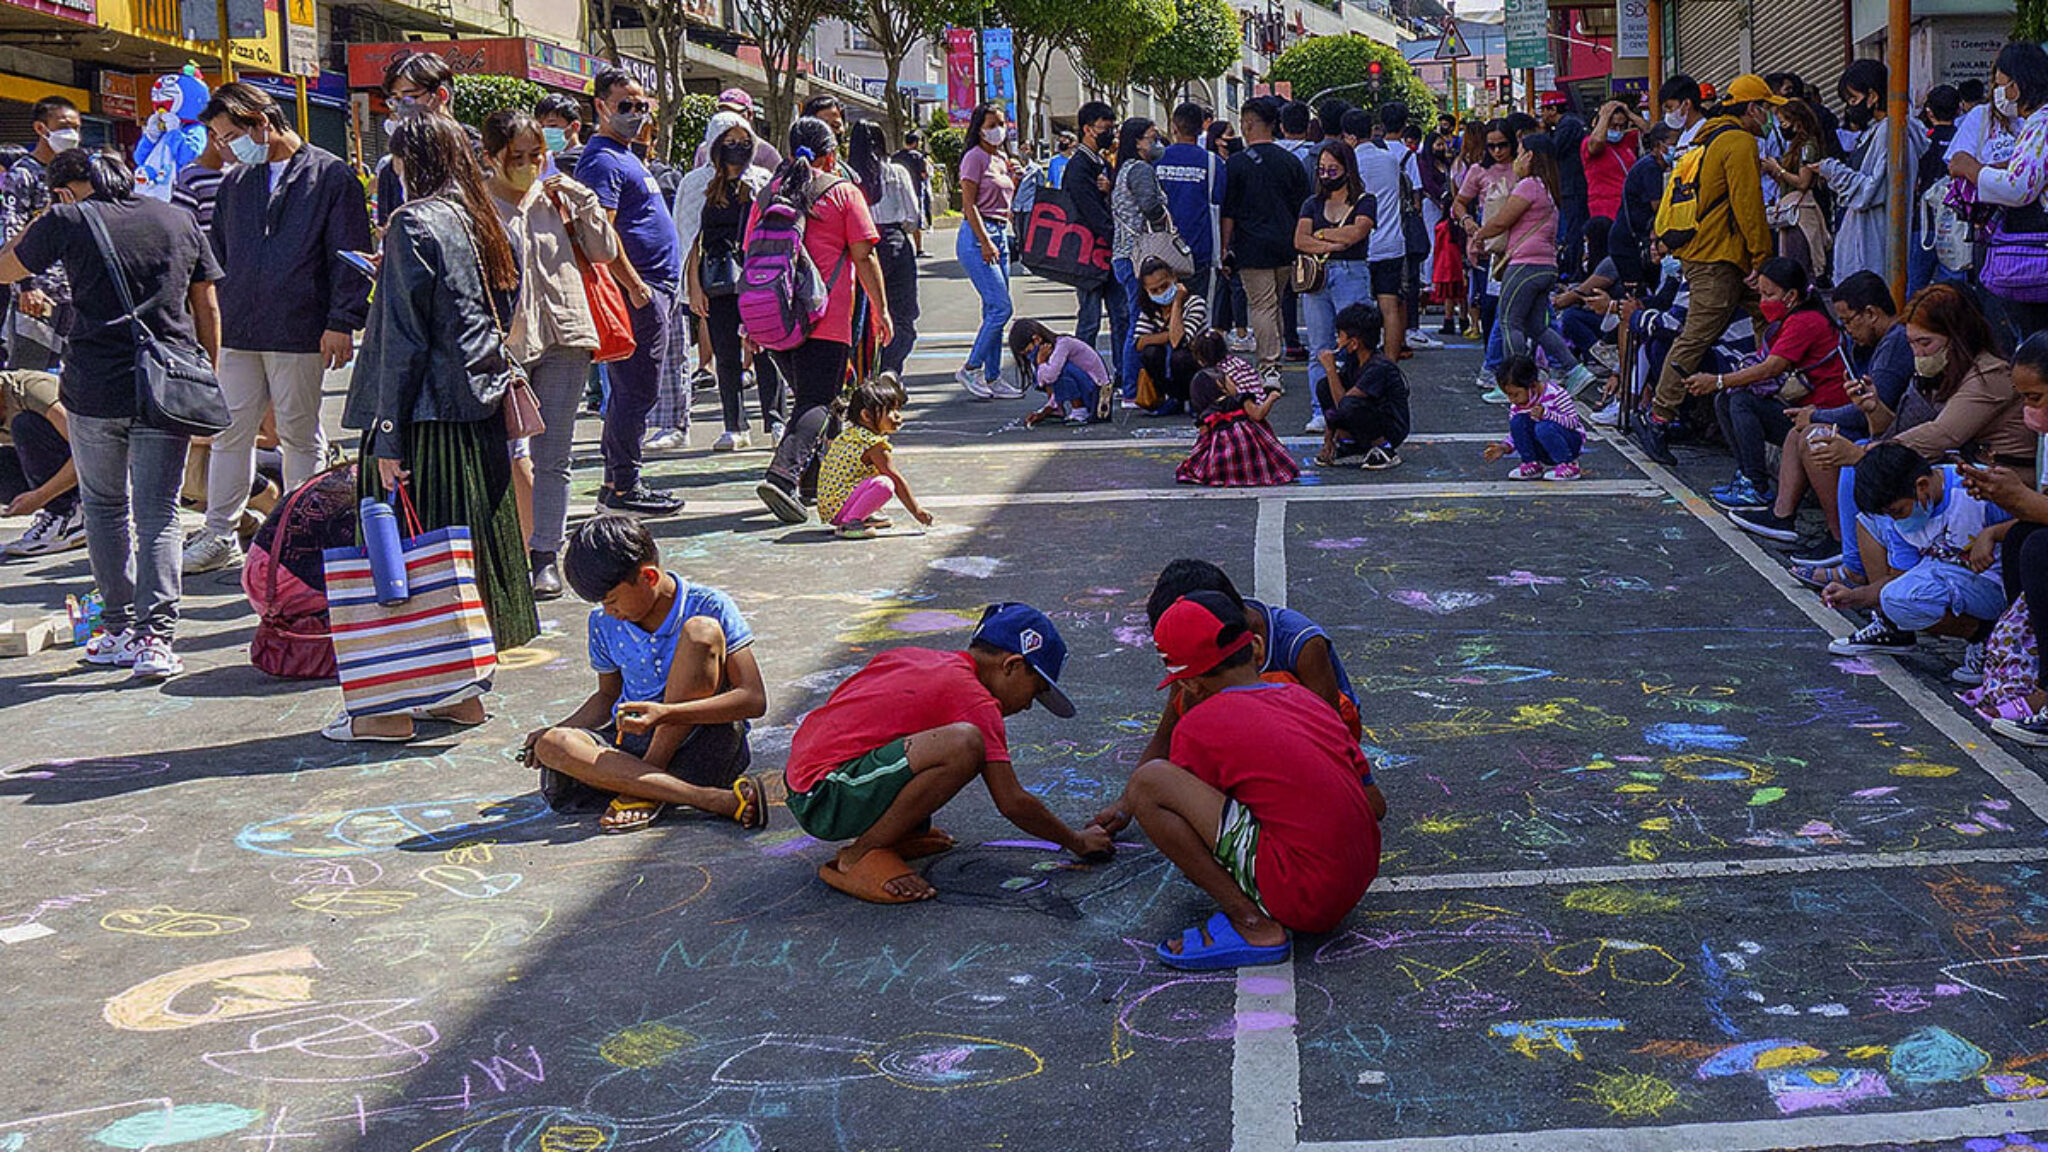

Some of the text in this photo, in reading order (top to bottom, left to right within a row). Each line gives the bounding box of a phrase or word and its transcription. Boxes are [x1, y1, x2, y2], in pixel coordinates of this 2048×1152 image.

[1626, 2, 1648, 17] SD
[230, 40, 273, 64] Pizza Co.
